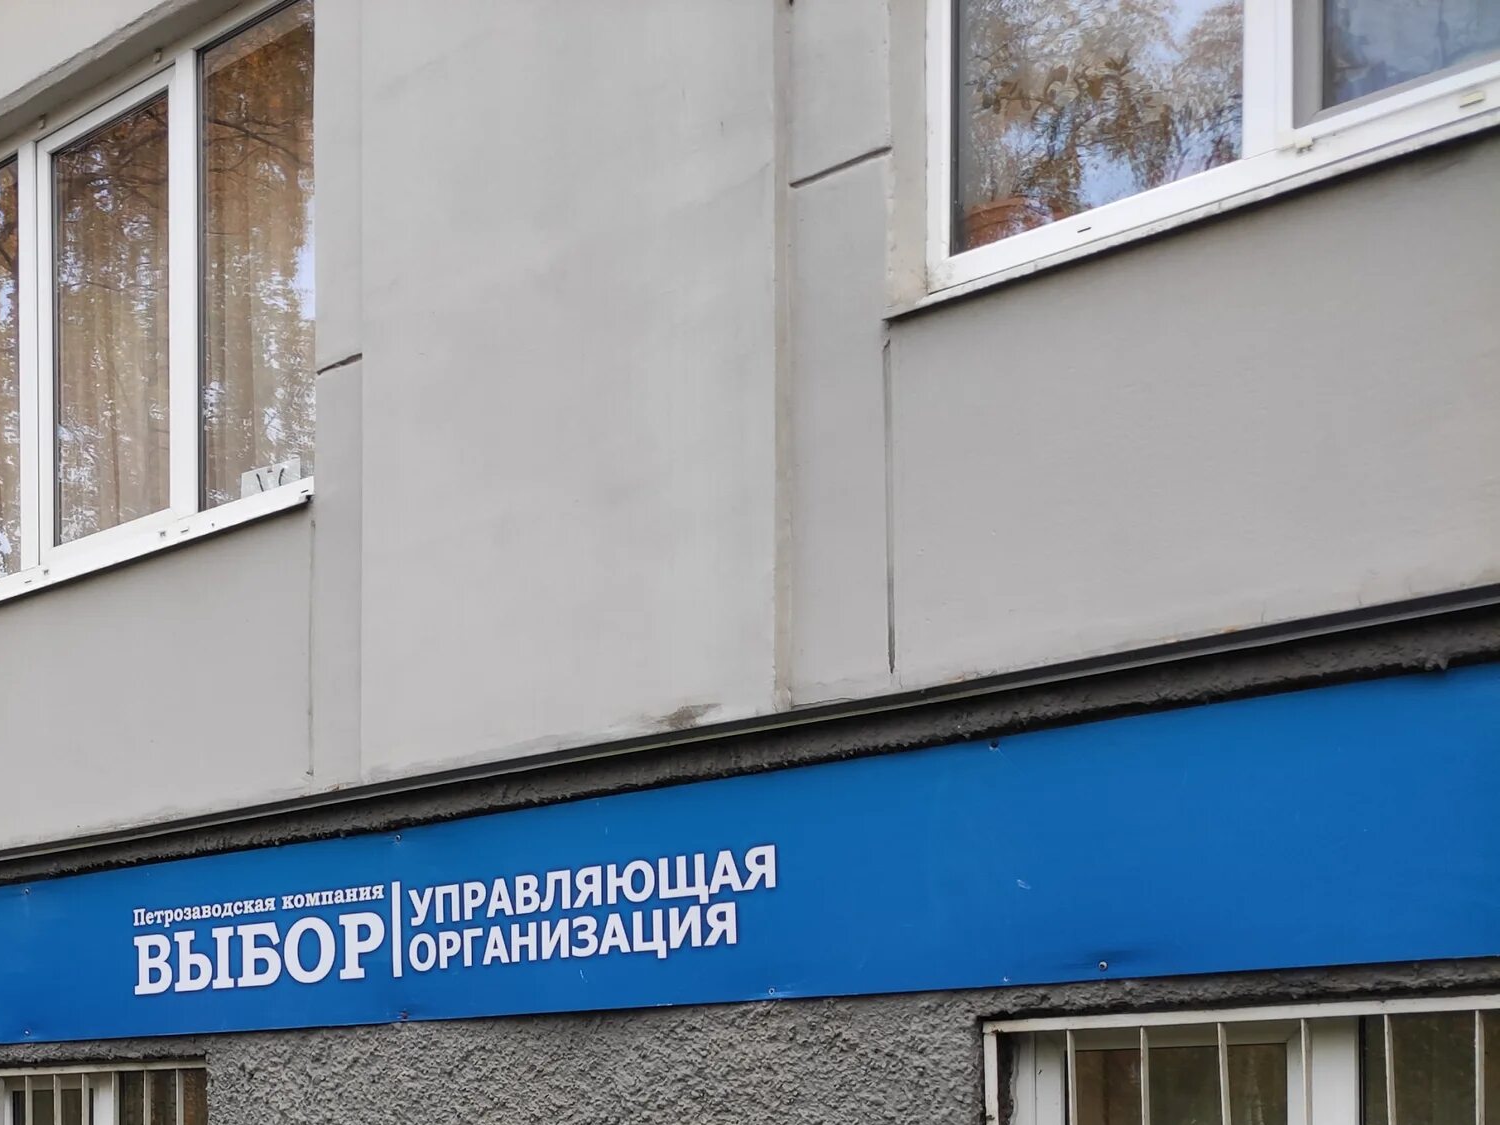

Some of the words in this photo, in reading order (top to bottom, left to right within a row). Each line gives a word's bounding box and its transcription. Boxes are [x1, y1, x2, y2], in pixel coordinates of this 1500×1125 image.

[132, 895, 276, 928] Петрозаводская
[281, 883, 386, 914] компания
[407, 844, 777, 927] УПРАВЛЯЮЩАЯ
[133, 911, 385, 996] ВЫБОР
[408, 902, 738, 973] ОРГАНИЗАЦИЯ
